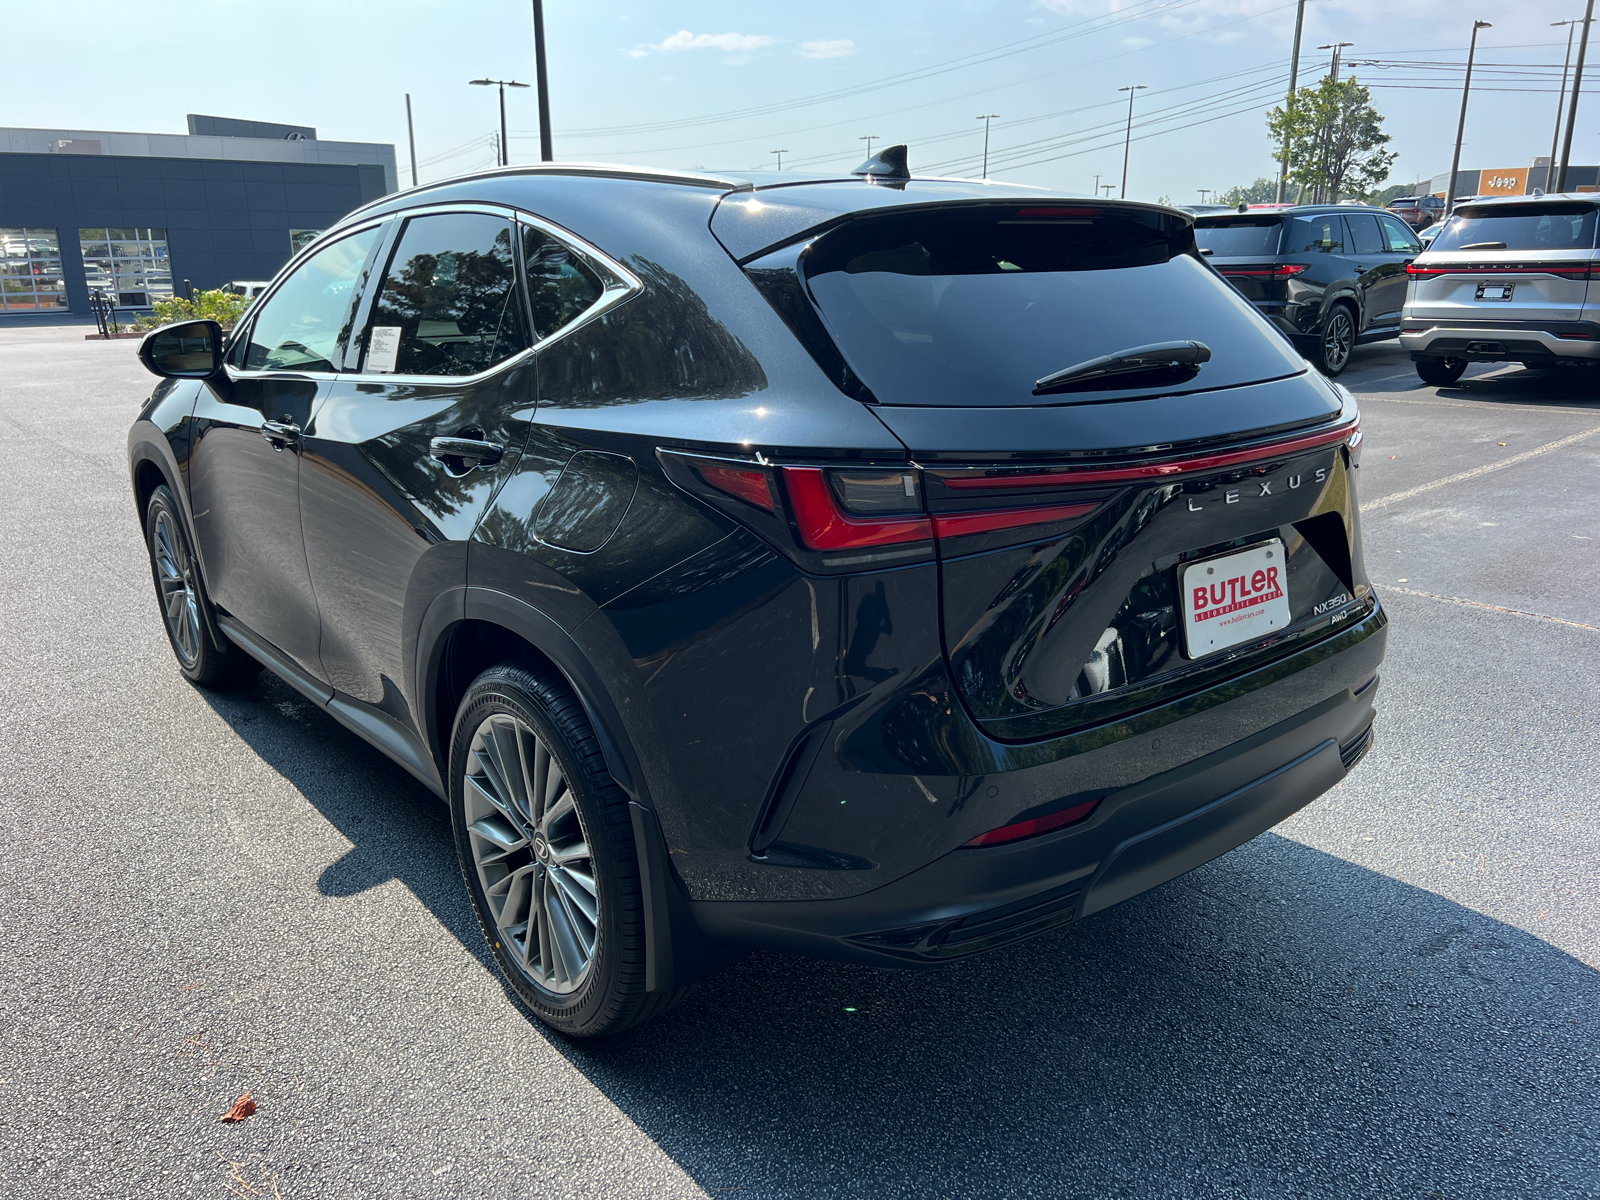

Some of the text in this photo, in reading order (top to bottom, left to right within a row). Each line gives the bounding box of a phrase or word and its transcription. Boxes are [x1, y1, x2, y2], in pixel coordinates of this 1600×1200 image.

[1488, 176, 1517, 189] Jeep
[1188, 468, 1326, 512] LEXUS
[1195, 590, 1283, 622] AUTOMOTIVE GROUP
[1313, 593, 1347, 616] NX350
[1219, 609, 1265, 627] www.butlercars.com
[1331, 610, 1347, 625] AWD
